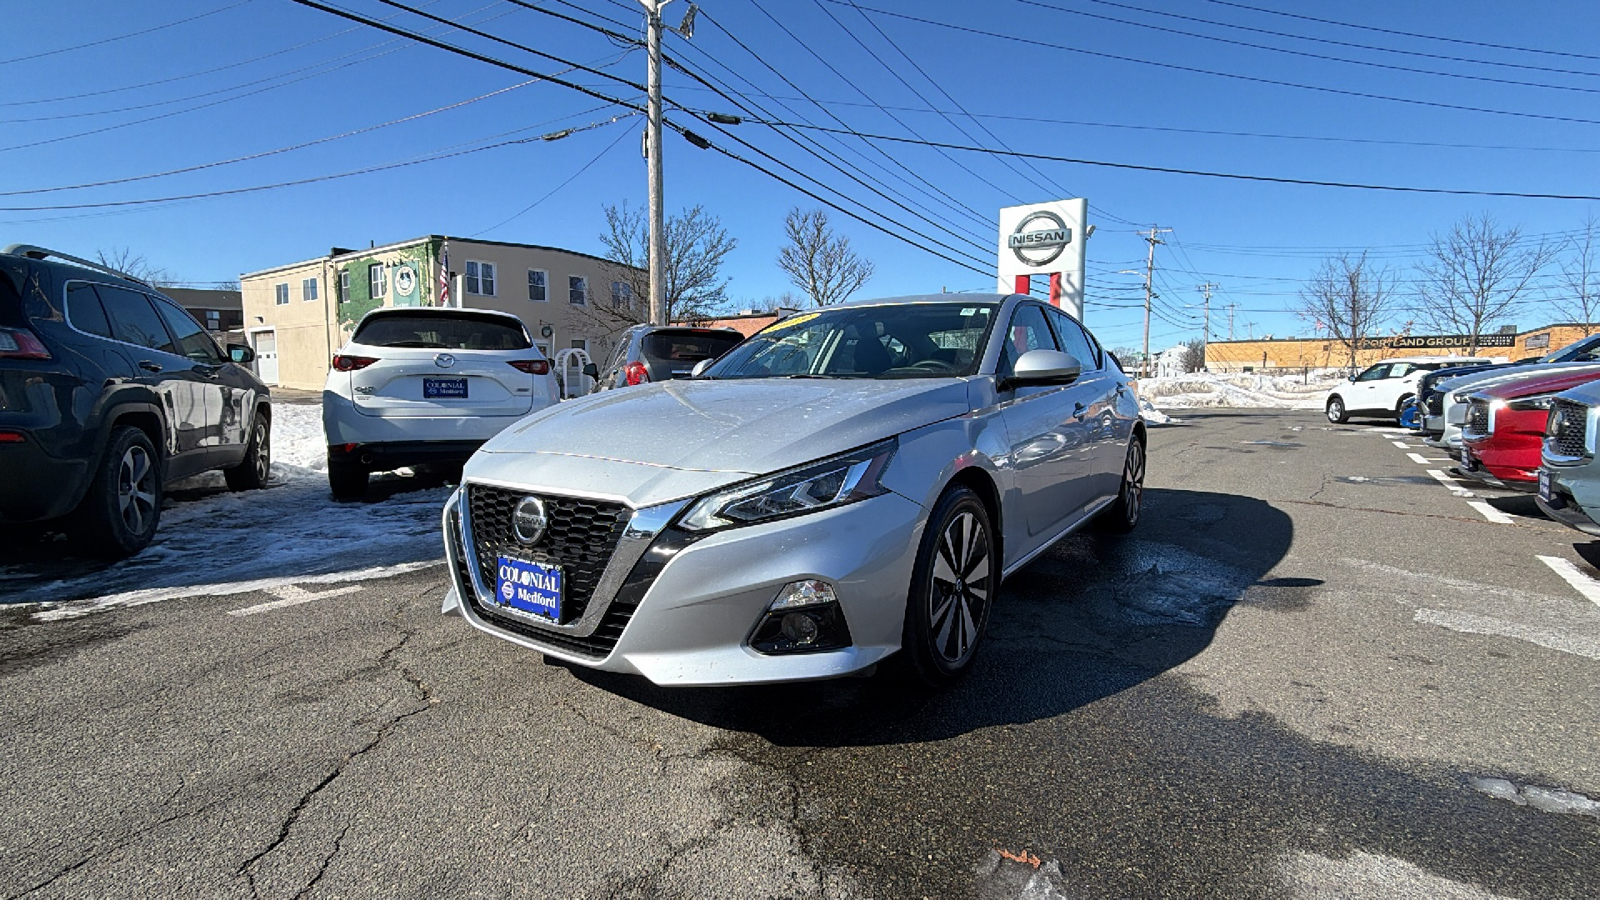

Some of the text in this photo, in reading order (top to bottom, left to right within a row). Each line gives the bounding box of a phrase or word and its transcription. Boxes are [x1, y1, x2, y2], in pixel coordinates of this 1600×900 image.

[1013, 231, 1065, 245] NISSAN
[499, 564, 559, 593] COLONIAL
[517, 587, 556, 609] Medford
